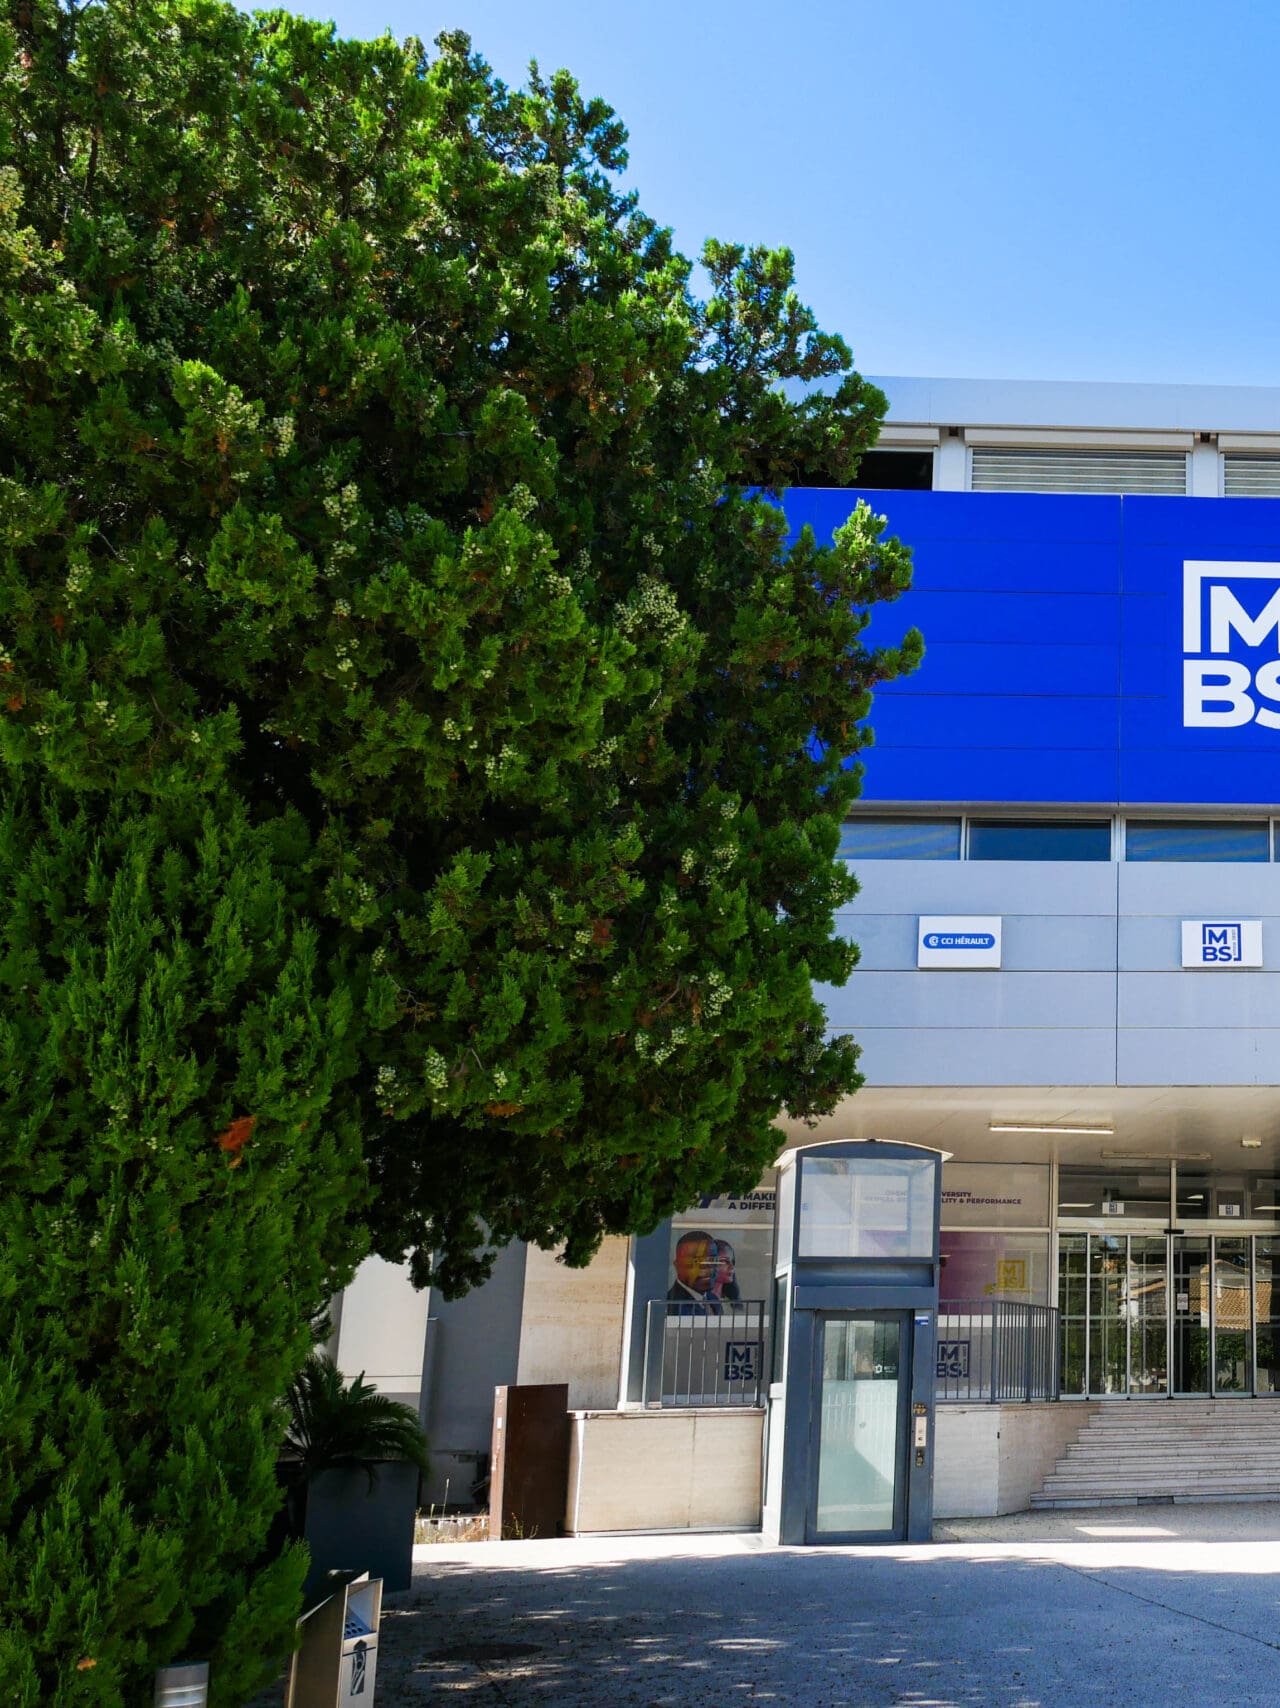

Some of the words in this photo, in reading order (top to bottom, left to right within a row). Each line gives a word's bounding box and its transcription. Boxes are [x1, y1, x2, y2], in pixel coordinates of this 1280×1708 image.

[941, 937, 954, 945] CCI
[954, 935, 990, 945] HÉRAULT
[966, 1197, 1022, 1205] PERFORMANCE
[728, 1202, 737, 1210] A
